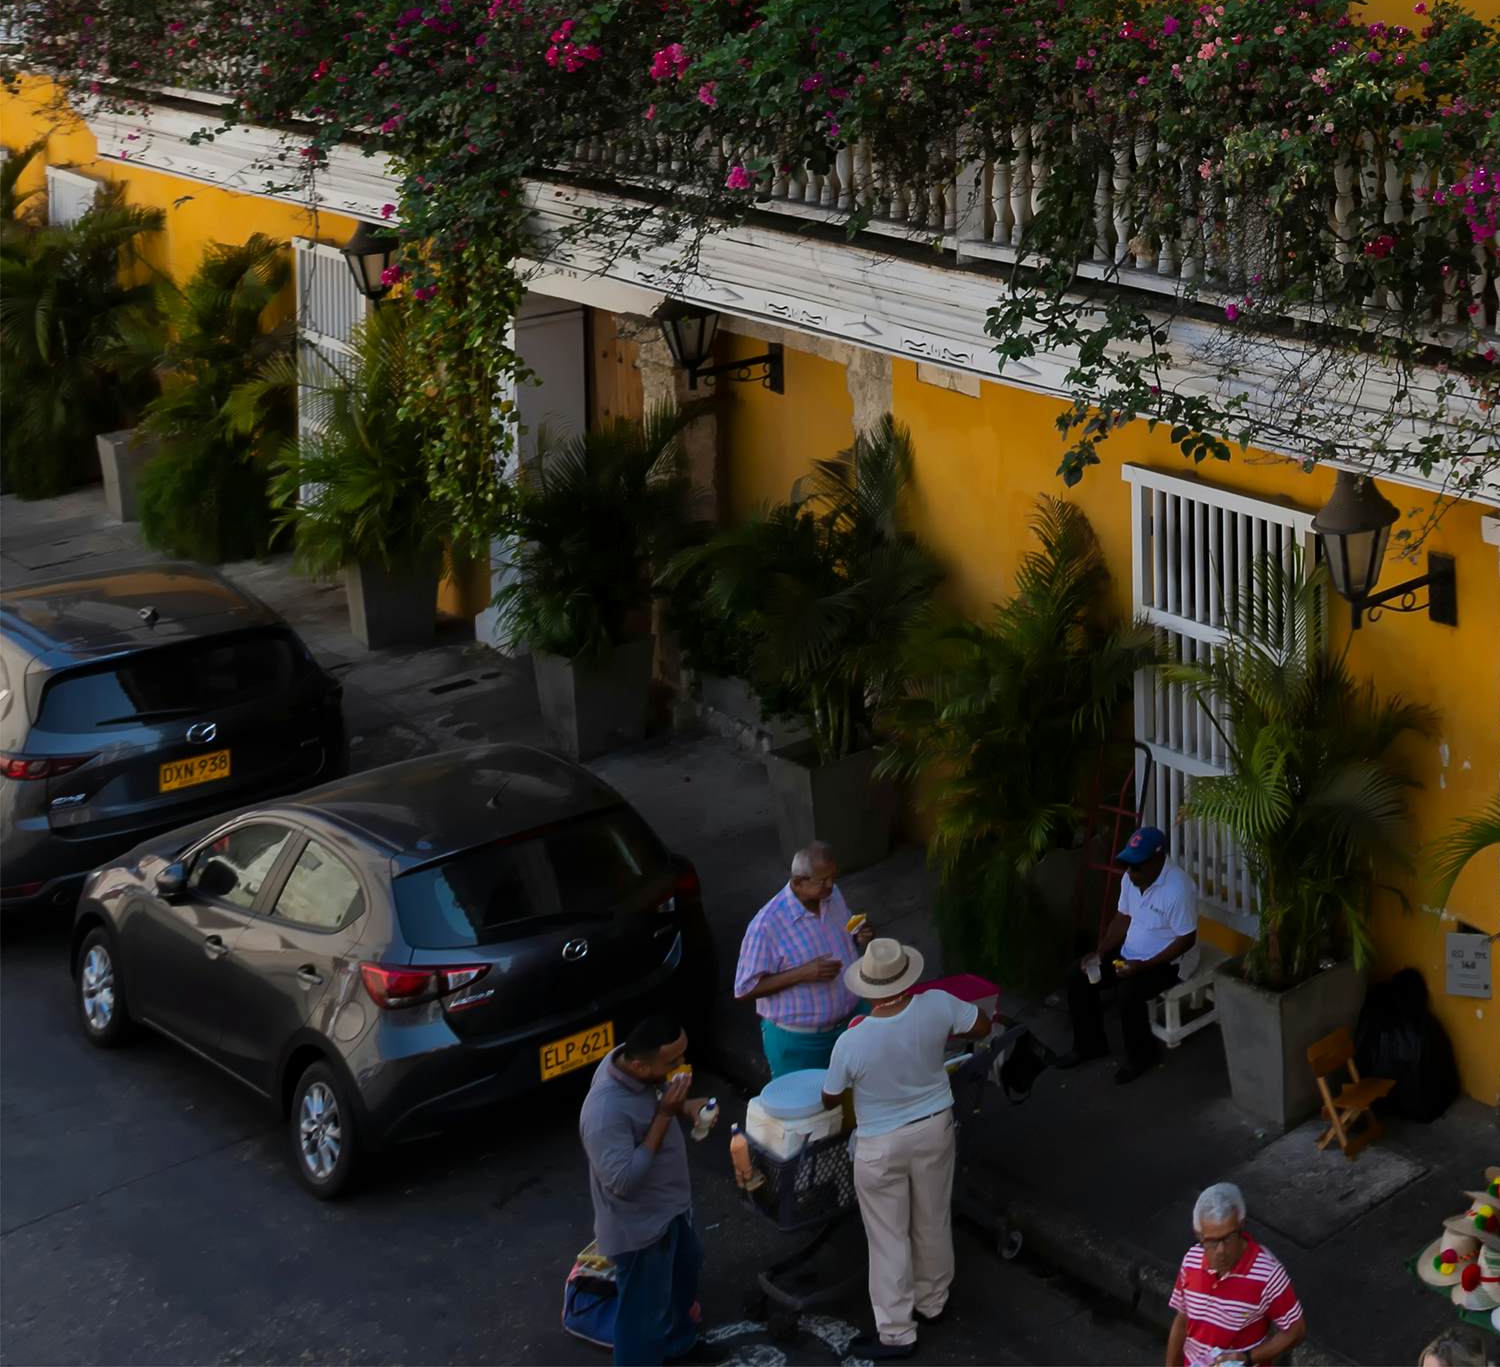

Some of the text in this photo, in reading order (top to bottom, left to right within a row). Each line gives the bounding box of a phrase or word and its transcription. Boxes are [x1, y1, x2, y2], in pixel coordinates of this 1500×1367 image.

[163, 762, 194, 784] DXN
[199, 753, 227, 776] 938
[544, 1042, 575, 1070] ELP
[581, 1028, 610, 1055] 621
